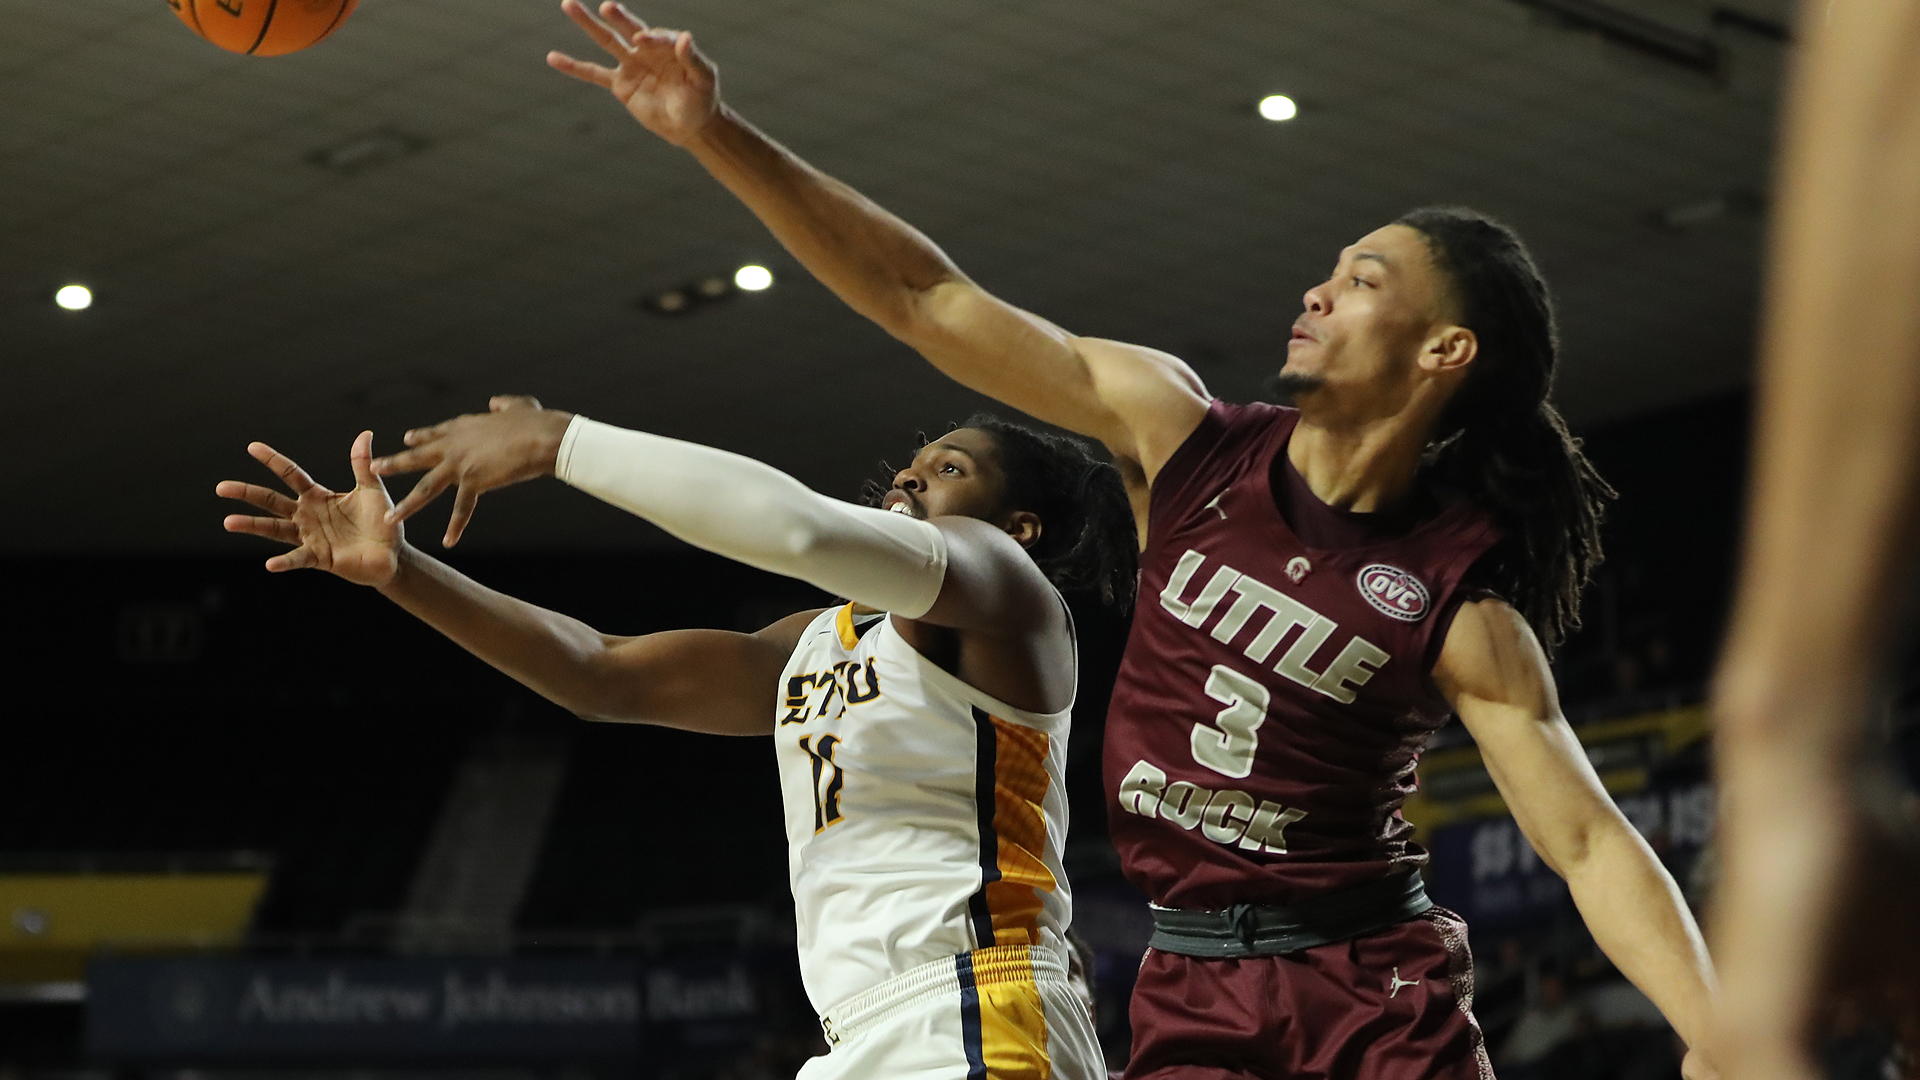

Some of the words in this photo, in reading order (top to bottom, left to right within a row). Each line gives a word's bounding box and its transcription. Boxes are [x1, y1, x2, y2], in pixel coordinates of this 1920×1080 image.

[1160, 549, 1391, 704] LITTLE
[1370, 575, 1418, 610] OVC
[1190, 664, 1270, 779] 3
[1118, 759, 1307, 854] ROCK
